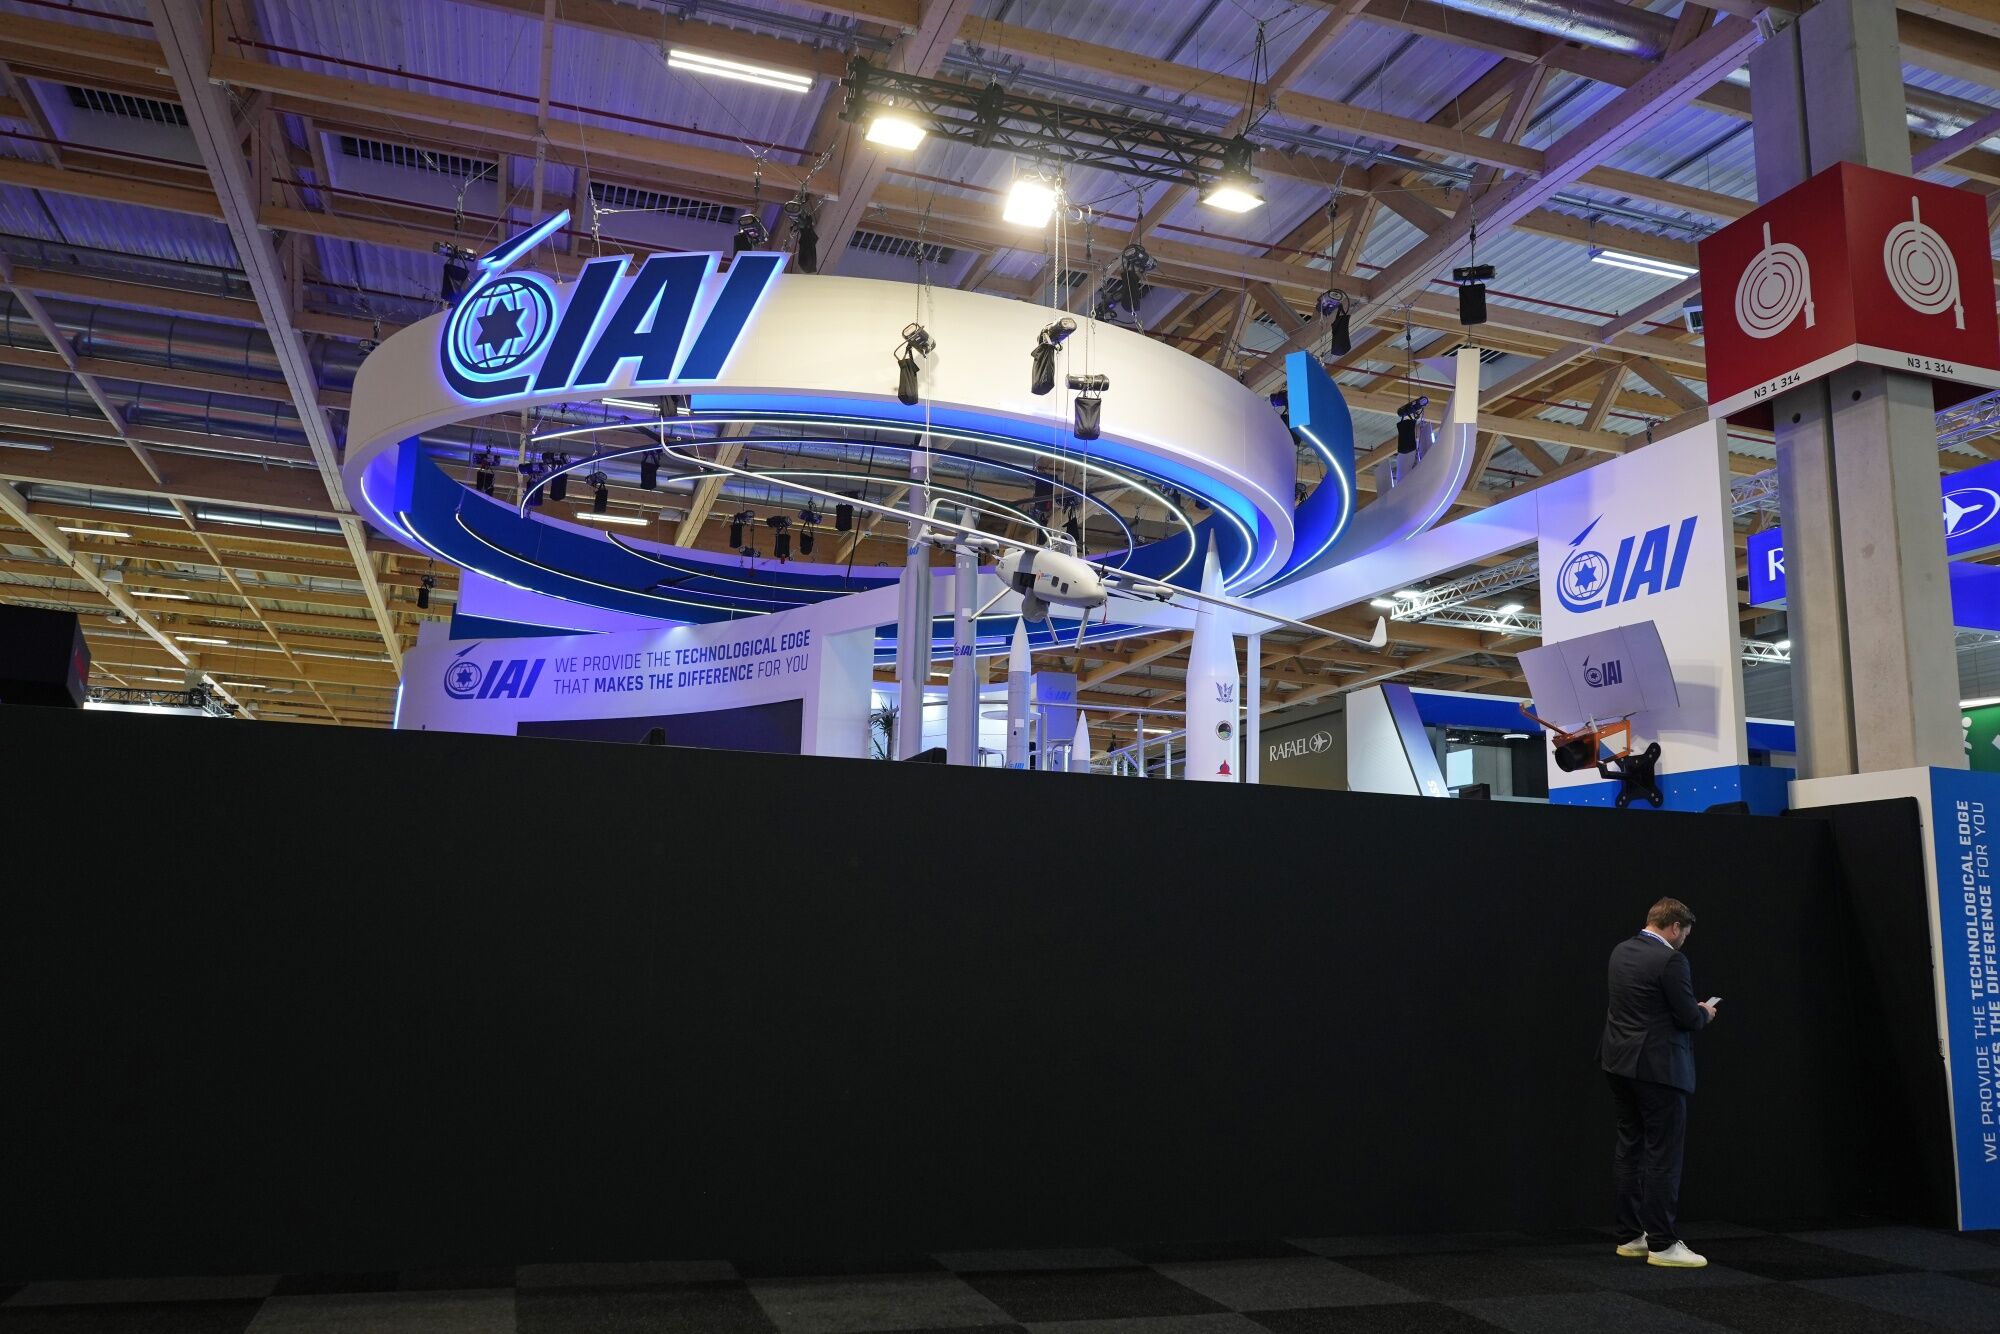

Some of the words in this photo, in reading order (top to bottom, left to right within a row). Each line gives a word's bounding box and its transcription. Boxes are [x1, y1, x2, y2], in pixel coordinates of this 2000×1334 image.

[533, 253, 783, 391] IAI
[1907, 357, 1921, 368] N3
[1925, 361, 1931, 370] 1
[1934, 362, 1953, 374] 314
[1754, 386, 1767, 399] N3
[1771, 382, 1777, 392] 1
[1780, 372, 1800, 388] 314
[1605, 515, 1698, 607] IAI
[555, 657, 578, 673] WE
[583, 653, 642, 671] PROVIDE
[646, 650, 671, 668] THE
[675, 636, 777, 665] TECHNOLOGICAL
[780, 629, 811, 651] EDGE
[475, 659, 546, 699] IAI
[554, 678, 589, 695] THAT
[594, 675, 644, 693] MAKES
[648, 672, 674, 690] THE
[678, 663, 754, 688] DIFFERENCE
[757, 659, 781, 678] FOR
[786, 653, 809, 674] YOU
[1601, 659, 1623, 687] IAI
[1269, 737, 1309, 762] RAFAEL
[1956, 800, 1971, 846] EDGE
[1971, 802, 1986, 836] YOU
[1976, 844, 1990, 878] FOR
[1961, 851, 1984, 1000] TECHNOLOGICAL
[1979, 885, 1999, 994] DIFFERENCE
[1973, 1005, 1987, 1039] THE
[1988, 1001, 2000, 1035] THE
[1976, 1046, 1994, 1125] PROVIDE
[1984, 1132, 1998, 1163] WE
